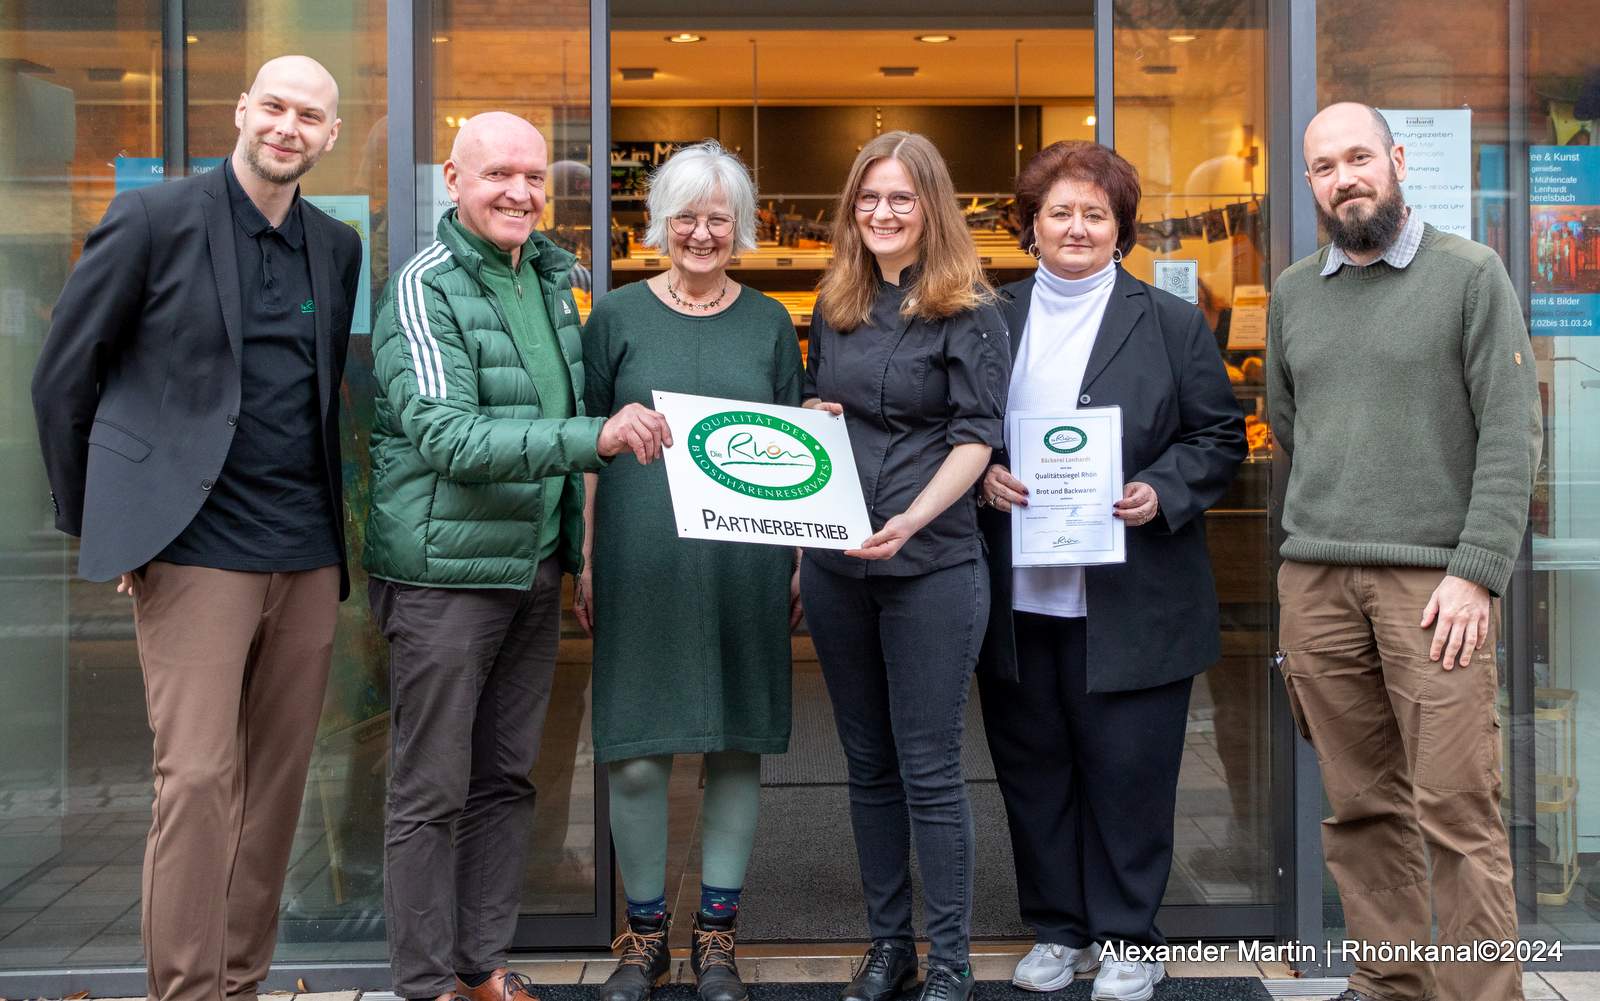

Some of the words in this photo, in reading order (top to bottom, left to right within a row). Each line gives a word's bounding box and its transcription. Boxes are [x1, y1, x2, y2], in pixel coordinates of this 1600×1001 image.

[1544, 152, 1551, 161] &
[1553, 152, 1580, 161] Kunst
[1557, 296, 1579, 305] Bilder
[1559, 319, 1592, 328] 31.03.24
[701, 414, 774, 432] QUALITÄT
[781, 422, 809, 442] DES
[728, 432, 813, 460] Rhön
[710, 450, 723, 459] Die
[1035, 472, 1080, 480] Qualitätssiegel
[702, 508, 849, 541] PARTNERBETRIEB
